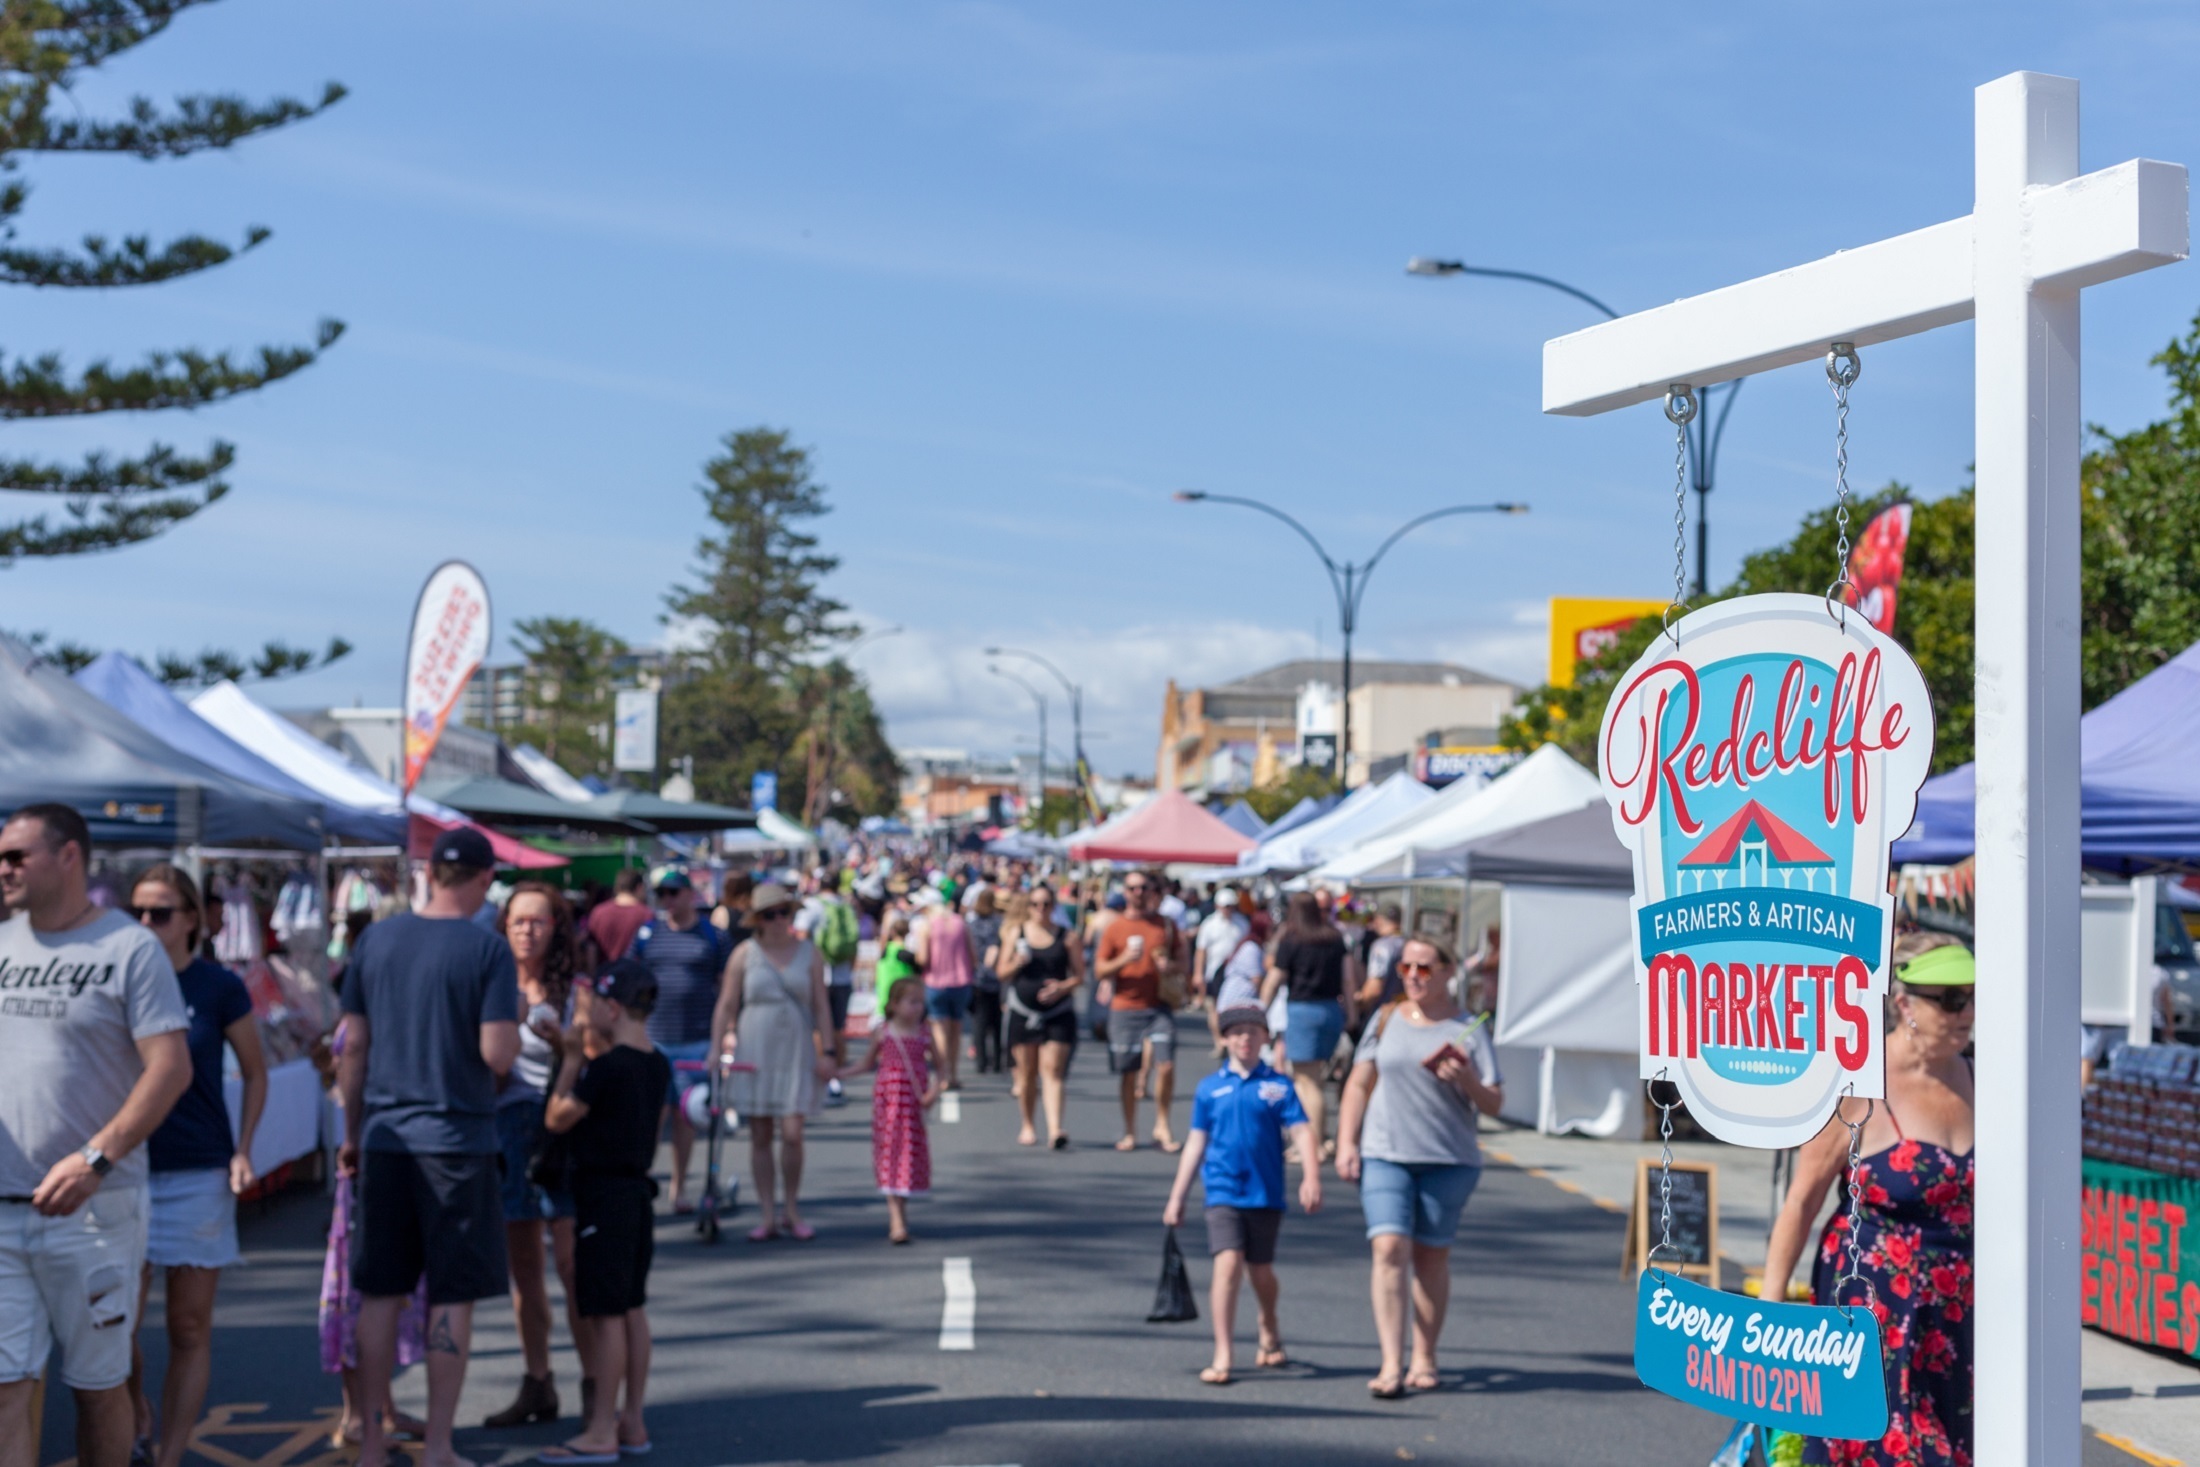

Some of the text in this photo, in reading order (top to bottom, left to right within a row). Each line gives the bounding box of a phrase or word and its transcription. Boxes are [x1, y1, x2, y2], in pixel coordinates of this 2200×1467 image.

[1607, 647, 1911, 834] Redcliffe
[1654, 900, 1855, 943] FARMERS & ARTISAN
[1648, 953, 1869, 1072] MARKETS
[1649, 1288, 1865, 1380] Every Sunday
